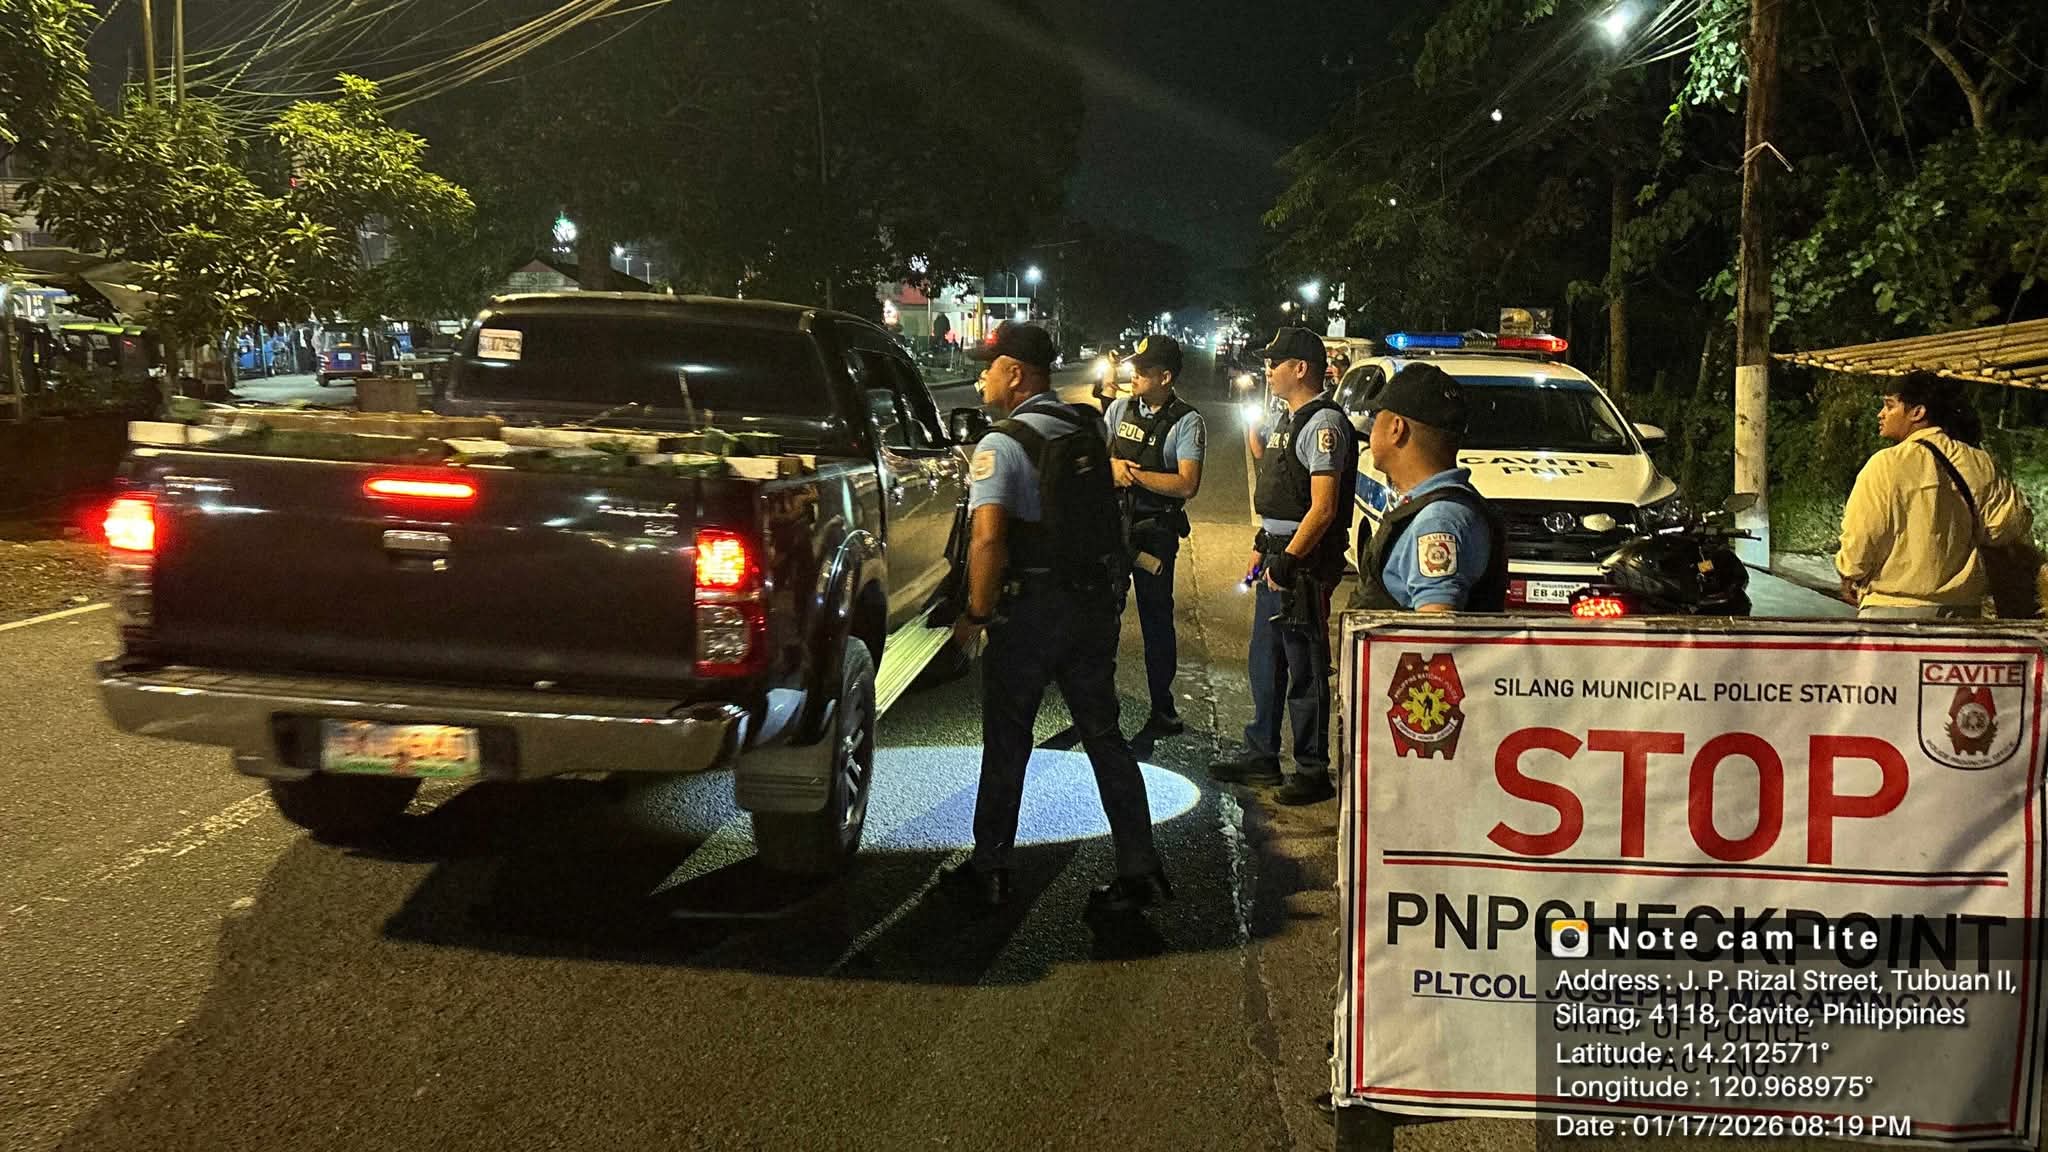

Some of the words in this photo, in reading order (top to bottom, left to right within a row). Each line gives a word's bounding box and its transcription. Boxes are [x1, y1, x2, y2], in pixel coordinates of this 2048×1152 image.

[1459, 457, 1614, 469] CAVITE
[1502, 466, 1584, 476] PNP
[1924, 664, 2021, 683] CAVITE
[1493, 677, 1575, 698] SILANG
[1582, 679, 1706, 702] MUNICIPAL
[1714, 683, 1792, 702] POLICE
[1799, 684, 1897, 705] STATION
[1486, 727, 1909, 865] STOP
[1387, 891, 1529, 950] PNP
[1534, 899, 2007, 974] CHECKPOINT
[1413, 969, 1537, 999] PLTCOL
